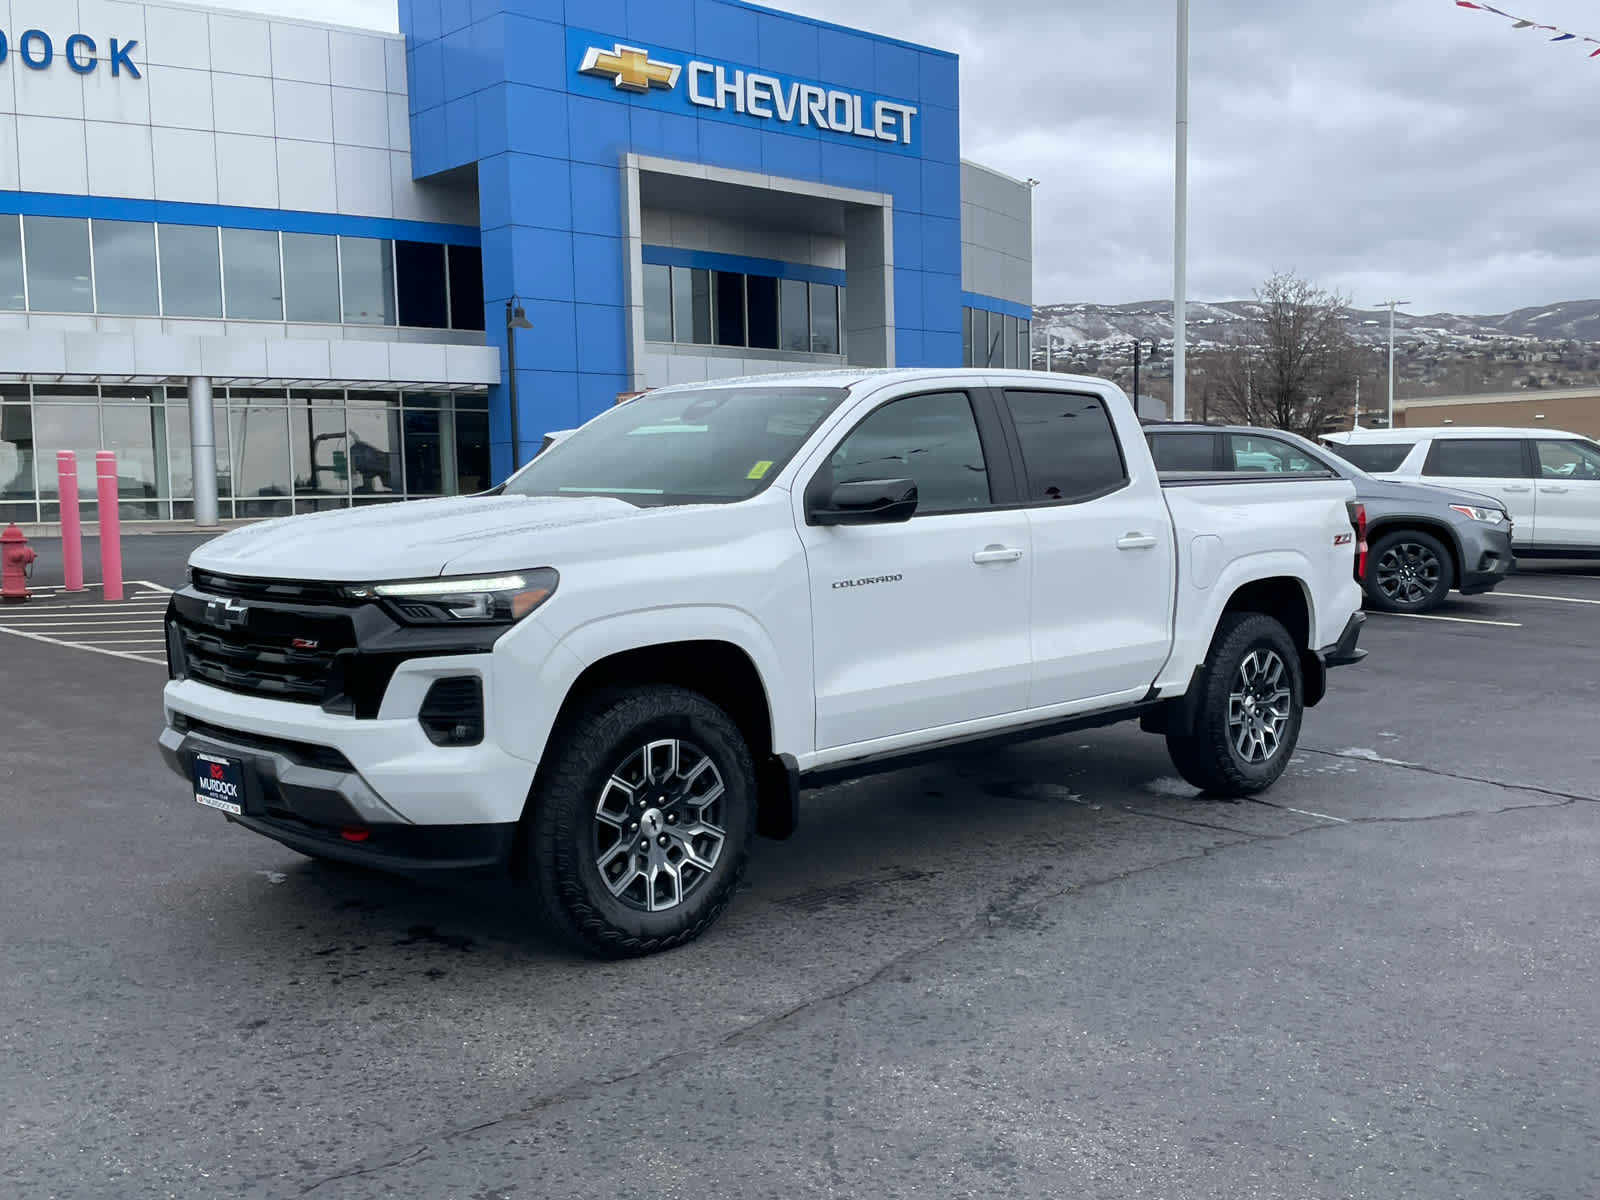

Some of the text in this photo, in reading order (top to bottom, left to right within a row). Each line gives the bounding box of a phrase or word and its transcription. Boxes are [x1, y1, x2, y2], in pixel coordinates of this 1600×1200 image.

[0, 28, 142, 79] OCK
[688, 60, 917, 144] CHEVROLET
[832, 574, 903, 589] COLORADO
[199, 776, 238, 797] MURDOCK
